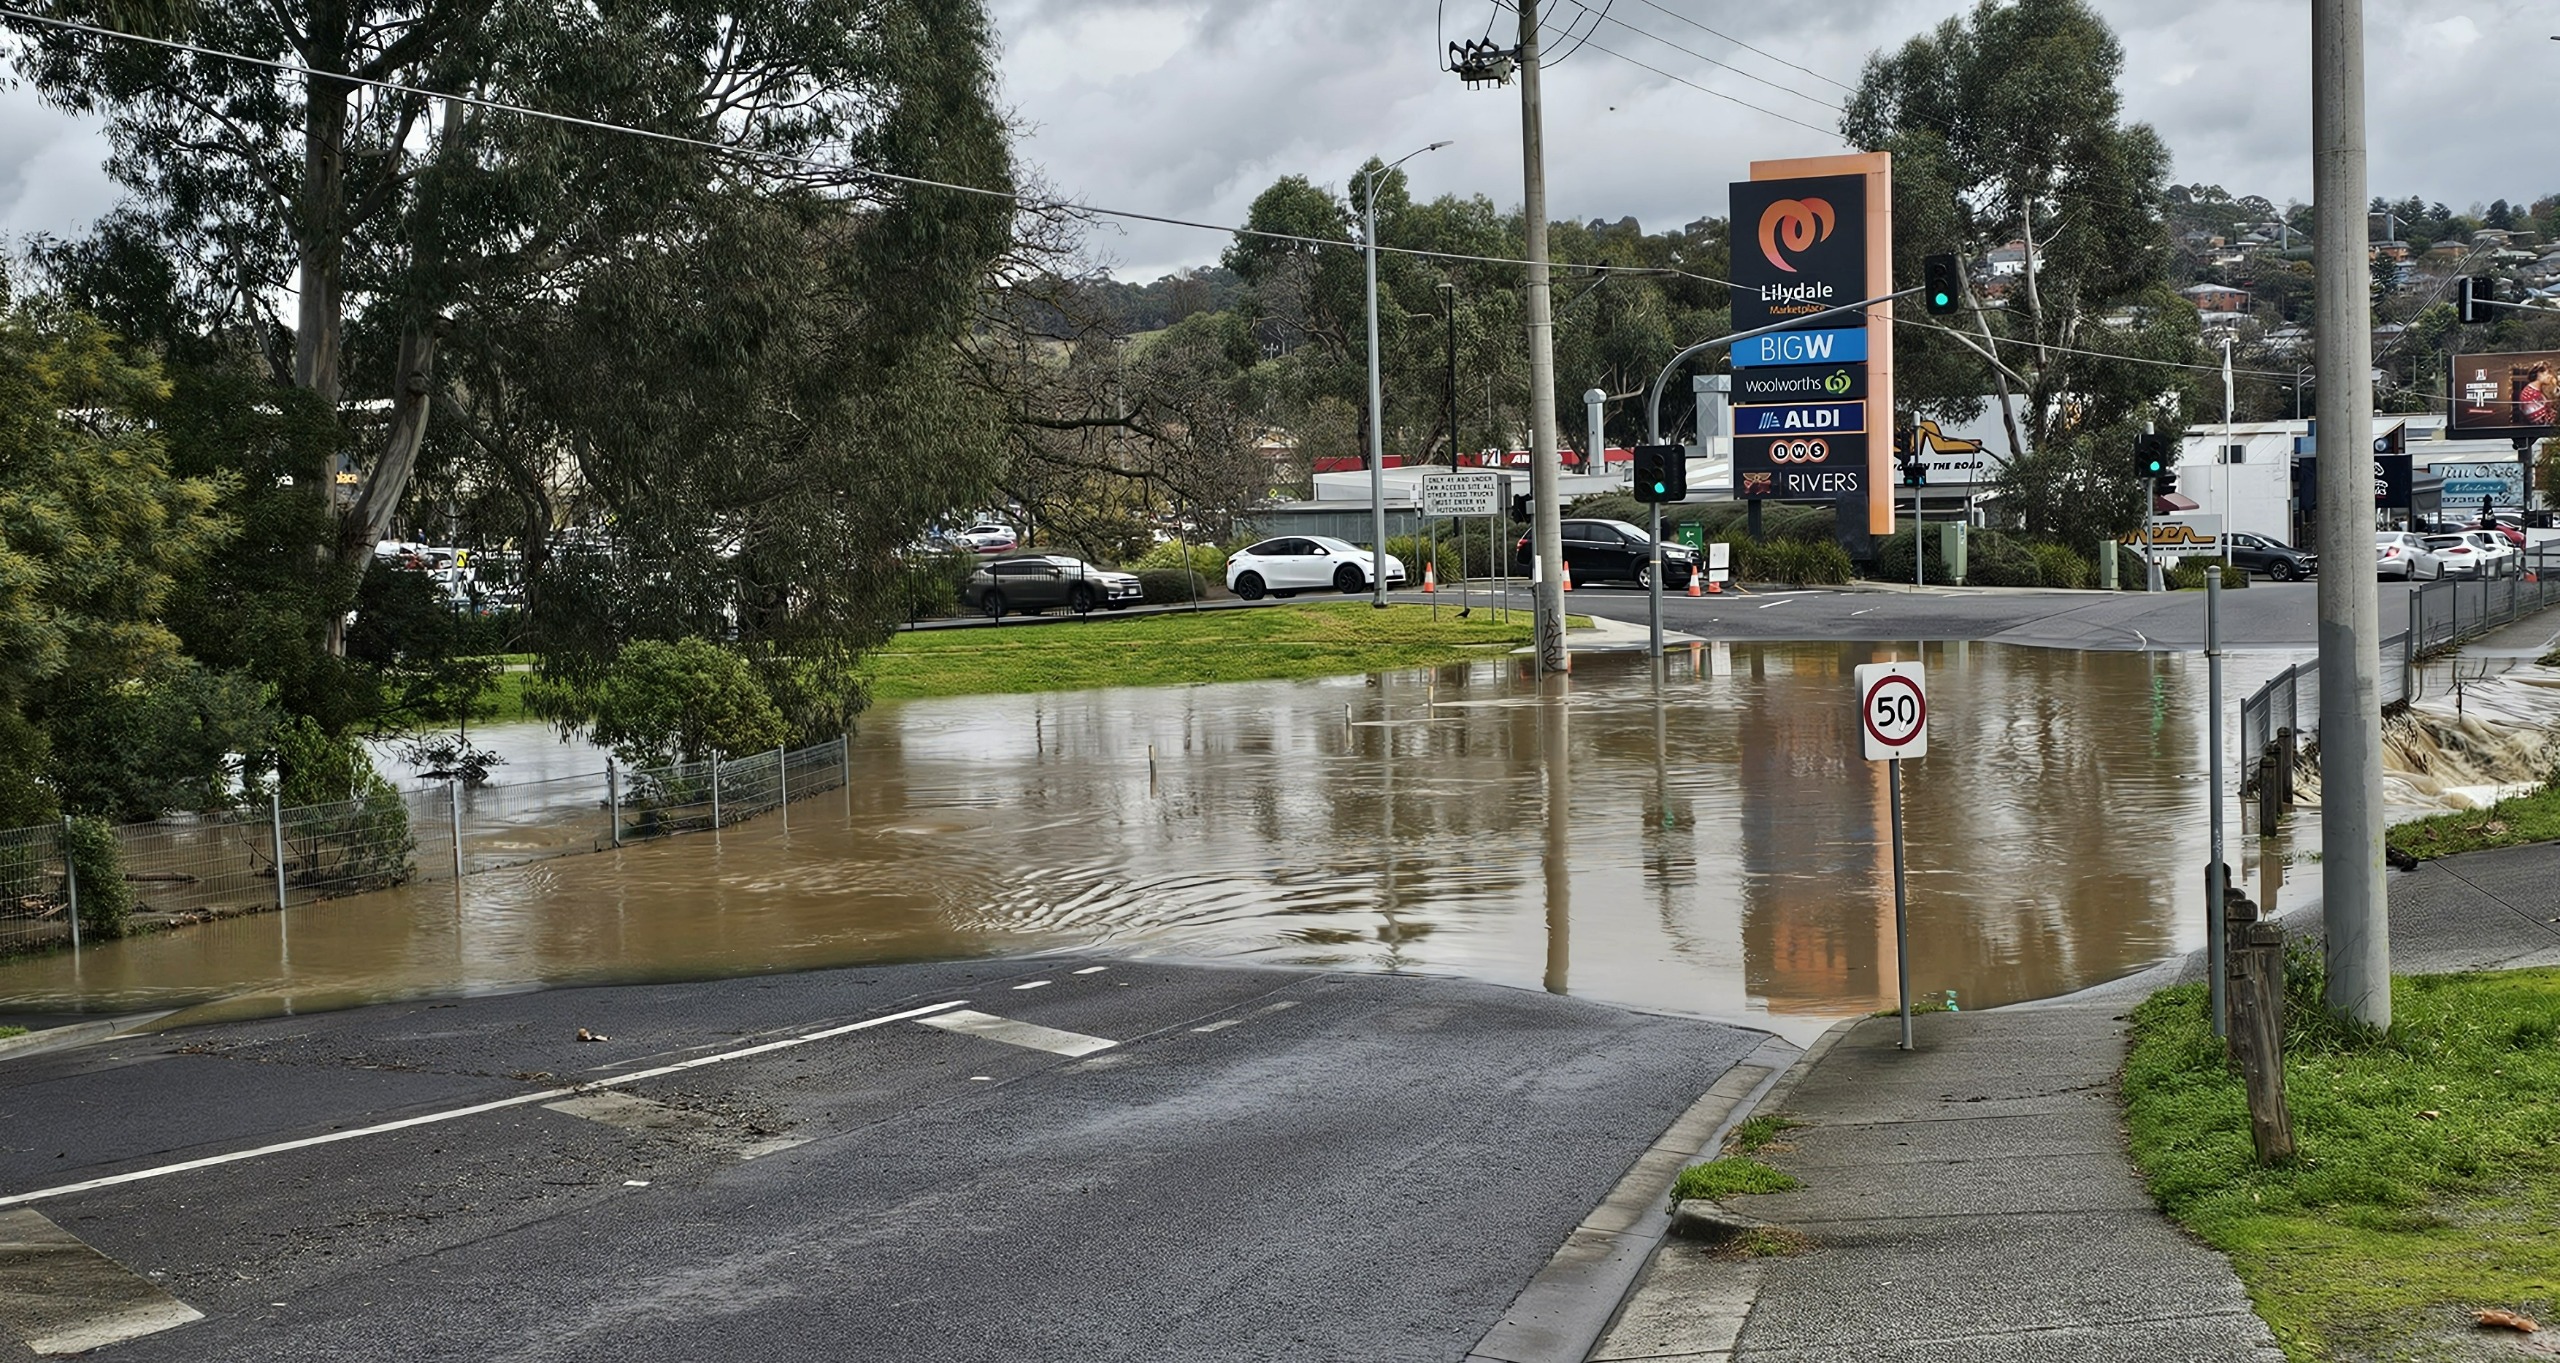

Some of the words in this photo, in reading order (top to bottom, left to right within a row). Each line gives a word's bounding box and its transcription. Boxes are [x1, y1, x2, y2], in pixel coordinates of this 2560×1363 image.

[1761, 281, 1833, 305] Lilydale
[1745, 376, 1822, 393] woolworths
[1784, 409, 1840, 429] ALDI
[1933, 462, 1951, 470] THE
[1954, 461, 1984, 470] ROAD
[1788, 472, 1858, 493] RIVERS
[1877, 694, 1916, 728] 50
